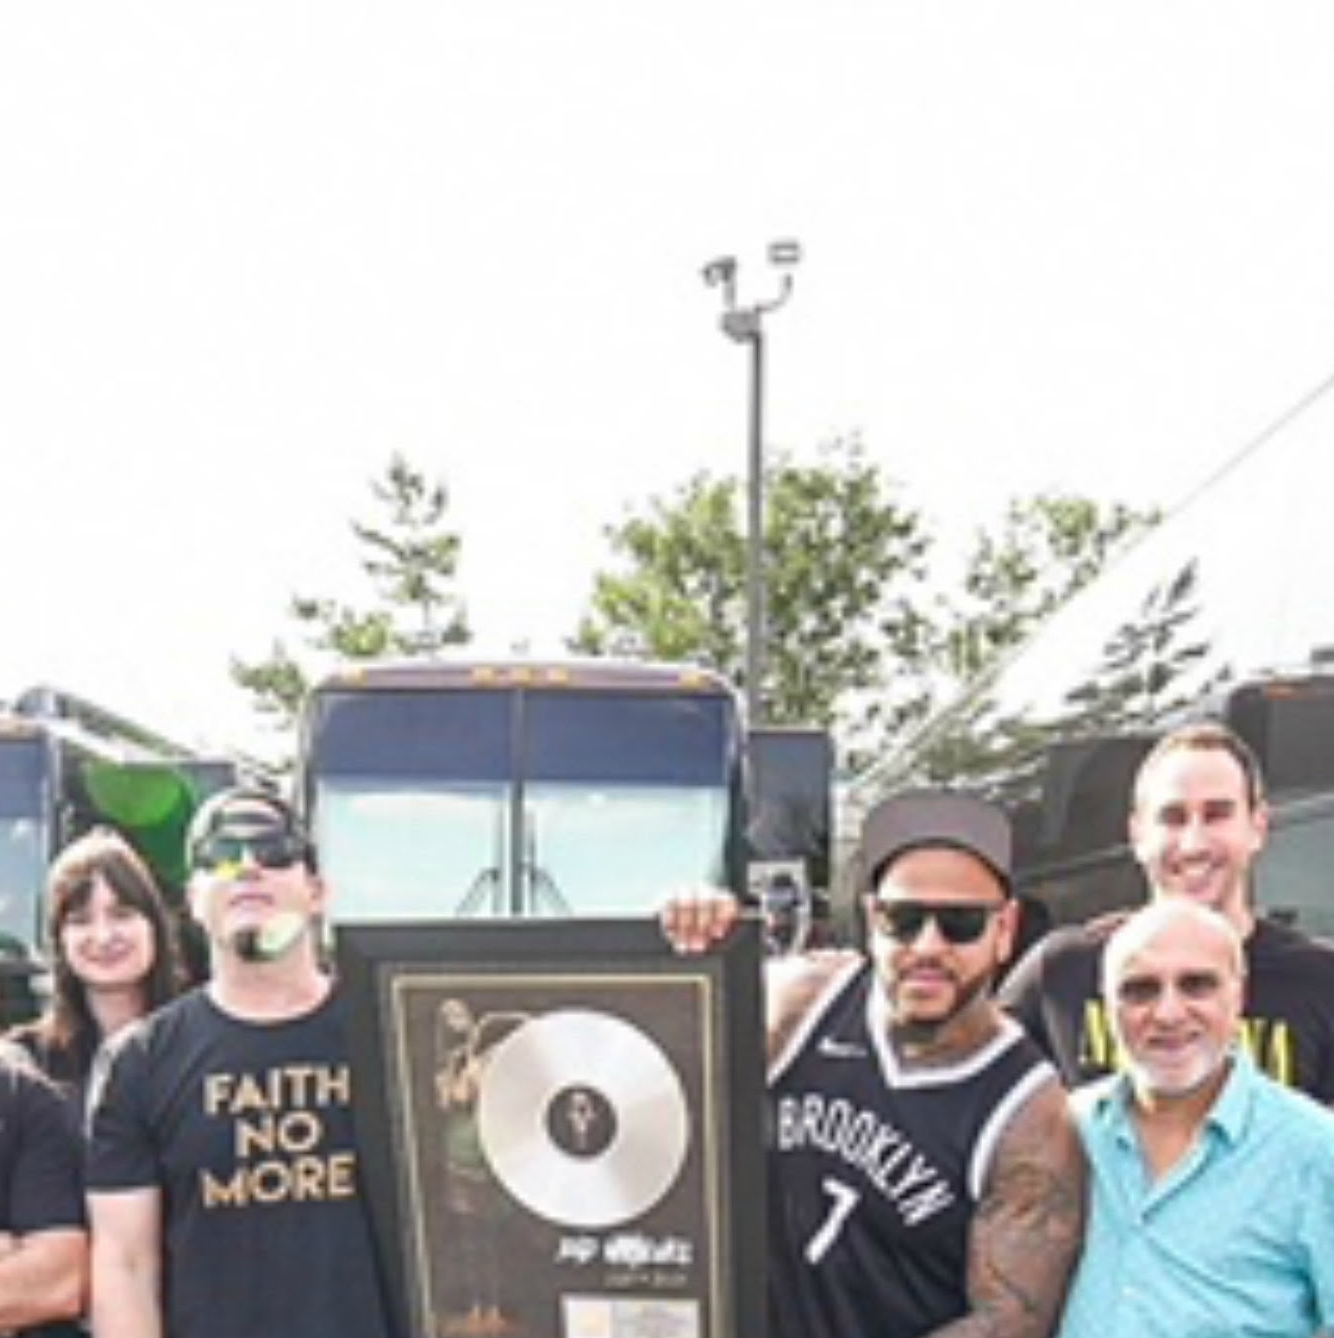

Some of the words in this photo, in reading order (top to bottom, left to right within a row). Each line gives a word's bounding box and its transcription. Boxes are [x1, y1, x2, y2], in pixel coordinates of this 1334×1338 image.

[204, 1064, 350, 1115] FAITH
[235, 1111, 322, 1157] NO
[778, 1093, 955, 1226] BROOKLYN
[200, 1153, 356, 1209] MORE
[804, 1178, 861, 1264] 7
